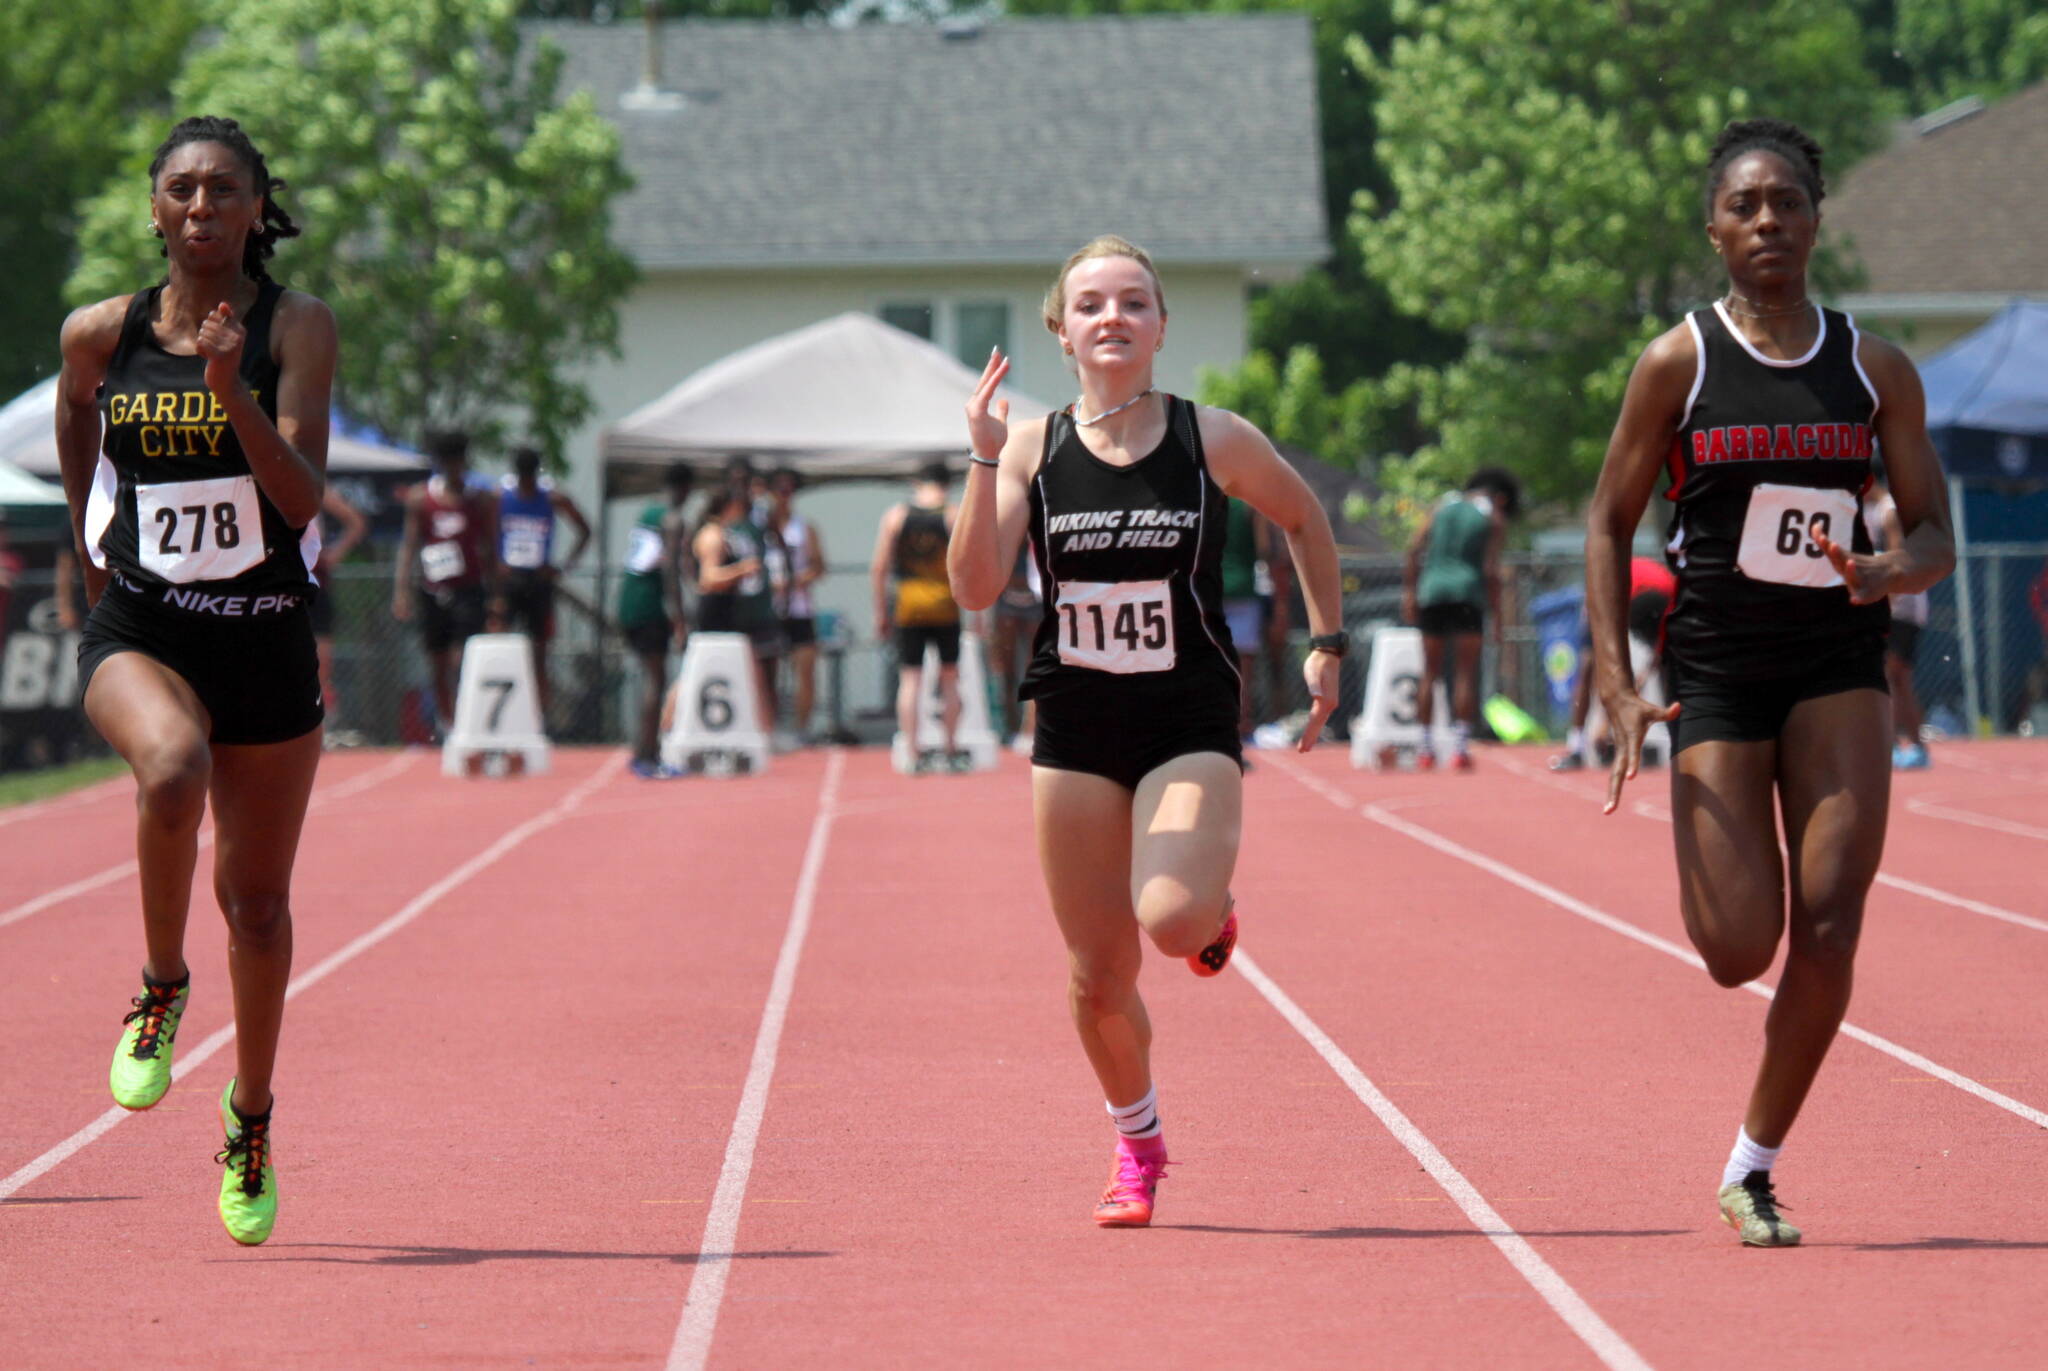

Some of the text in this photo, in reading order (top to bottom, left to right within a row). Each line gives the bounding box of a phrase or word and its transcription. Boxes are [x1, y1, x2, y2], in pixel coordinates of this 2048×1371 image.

[110, 389, 260, 425] GARDE
[140, 425, 225, 456] CITY
[155, 502, 240, 555] 278
[1049, 510, 1200, 534] VIKING TRACK
[1062, 530, 1181, 552] AND FIELD
[163, 588, 247, 616] NIKE
[1060, 600, 1167, 651] 1145
[480, 679, 515, 734] 7
[699, 677, 732, 731] 6
[1391, 673, 1421, 725] 3
